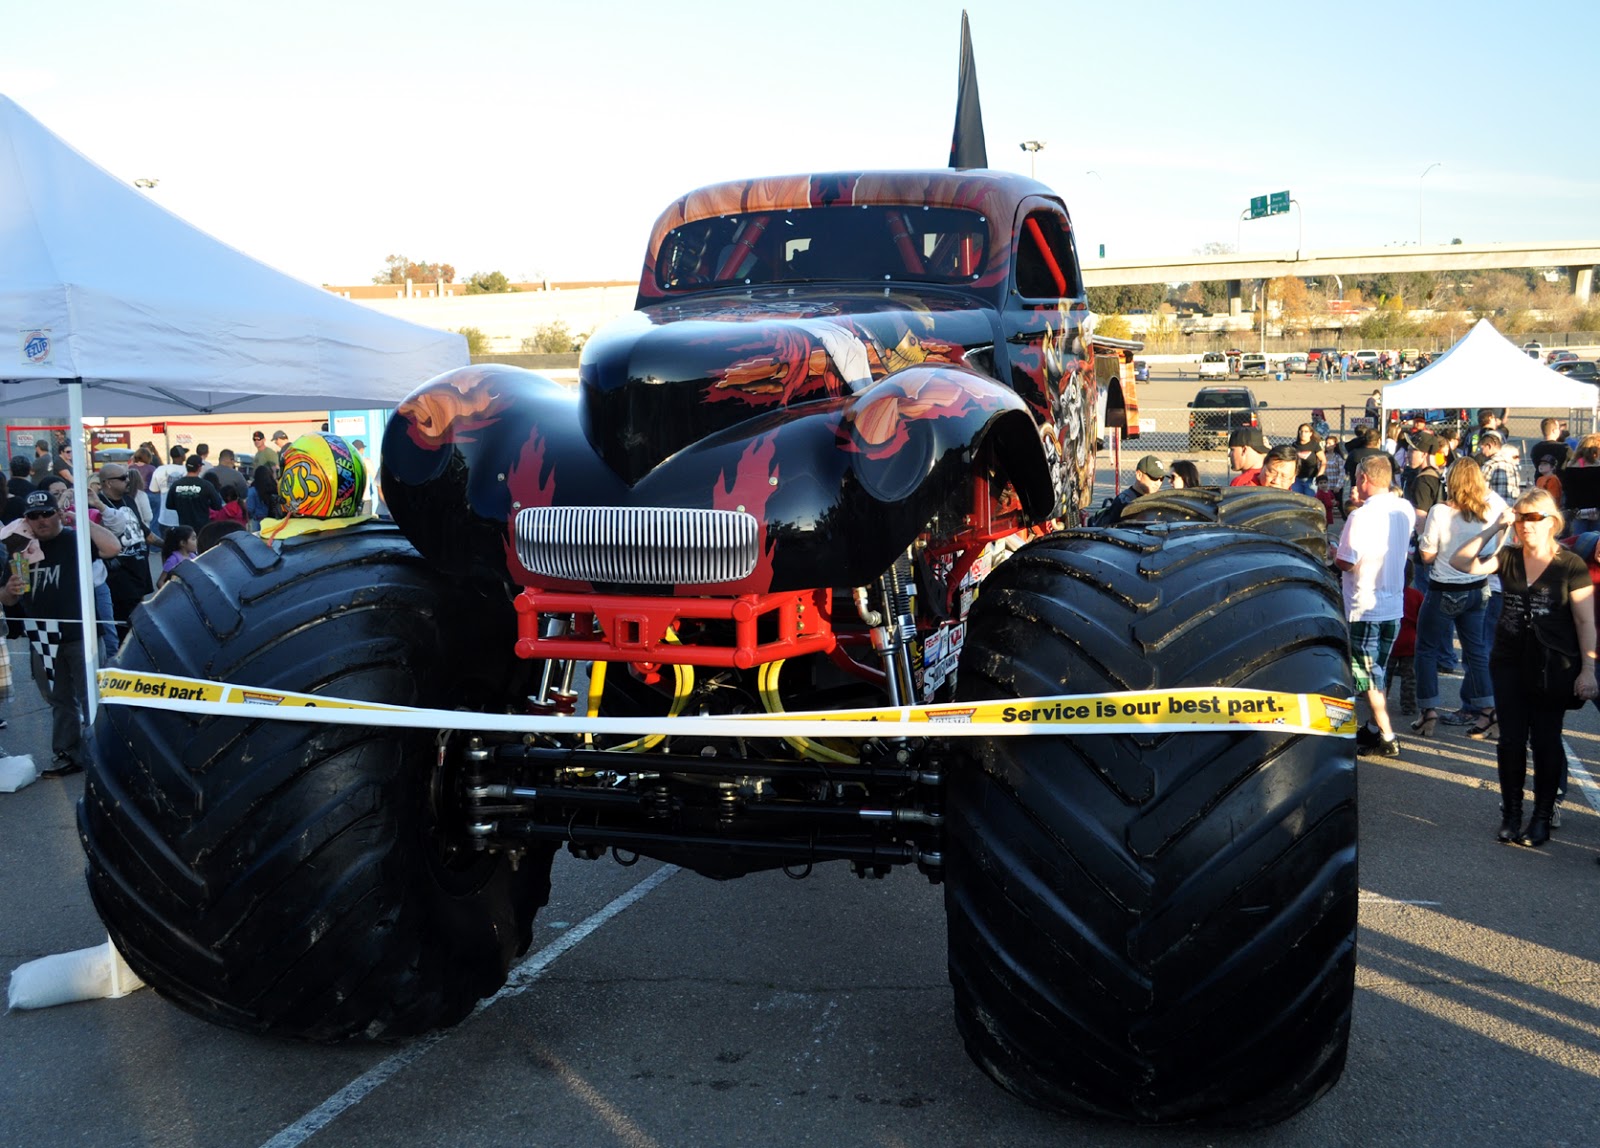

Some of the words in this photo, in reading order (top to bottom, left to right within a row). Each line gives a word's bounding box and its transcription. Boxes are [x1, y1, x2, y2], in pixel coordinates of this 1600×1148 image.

[109, 677, 132, 691] our
[134, 678, 166, 697] best
[168, 686, 208, 702] part.
[1001, 703, 1090, 723] Service
[1096, 701, 1117, 718] is
[1122, 701, 1160, 716] our
[1168, 696, 1221, 713] best
[1228, 695, 1284, 716] part.
